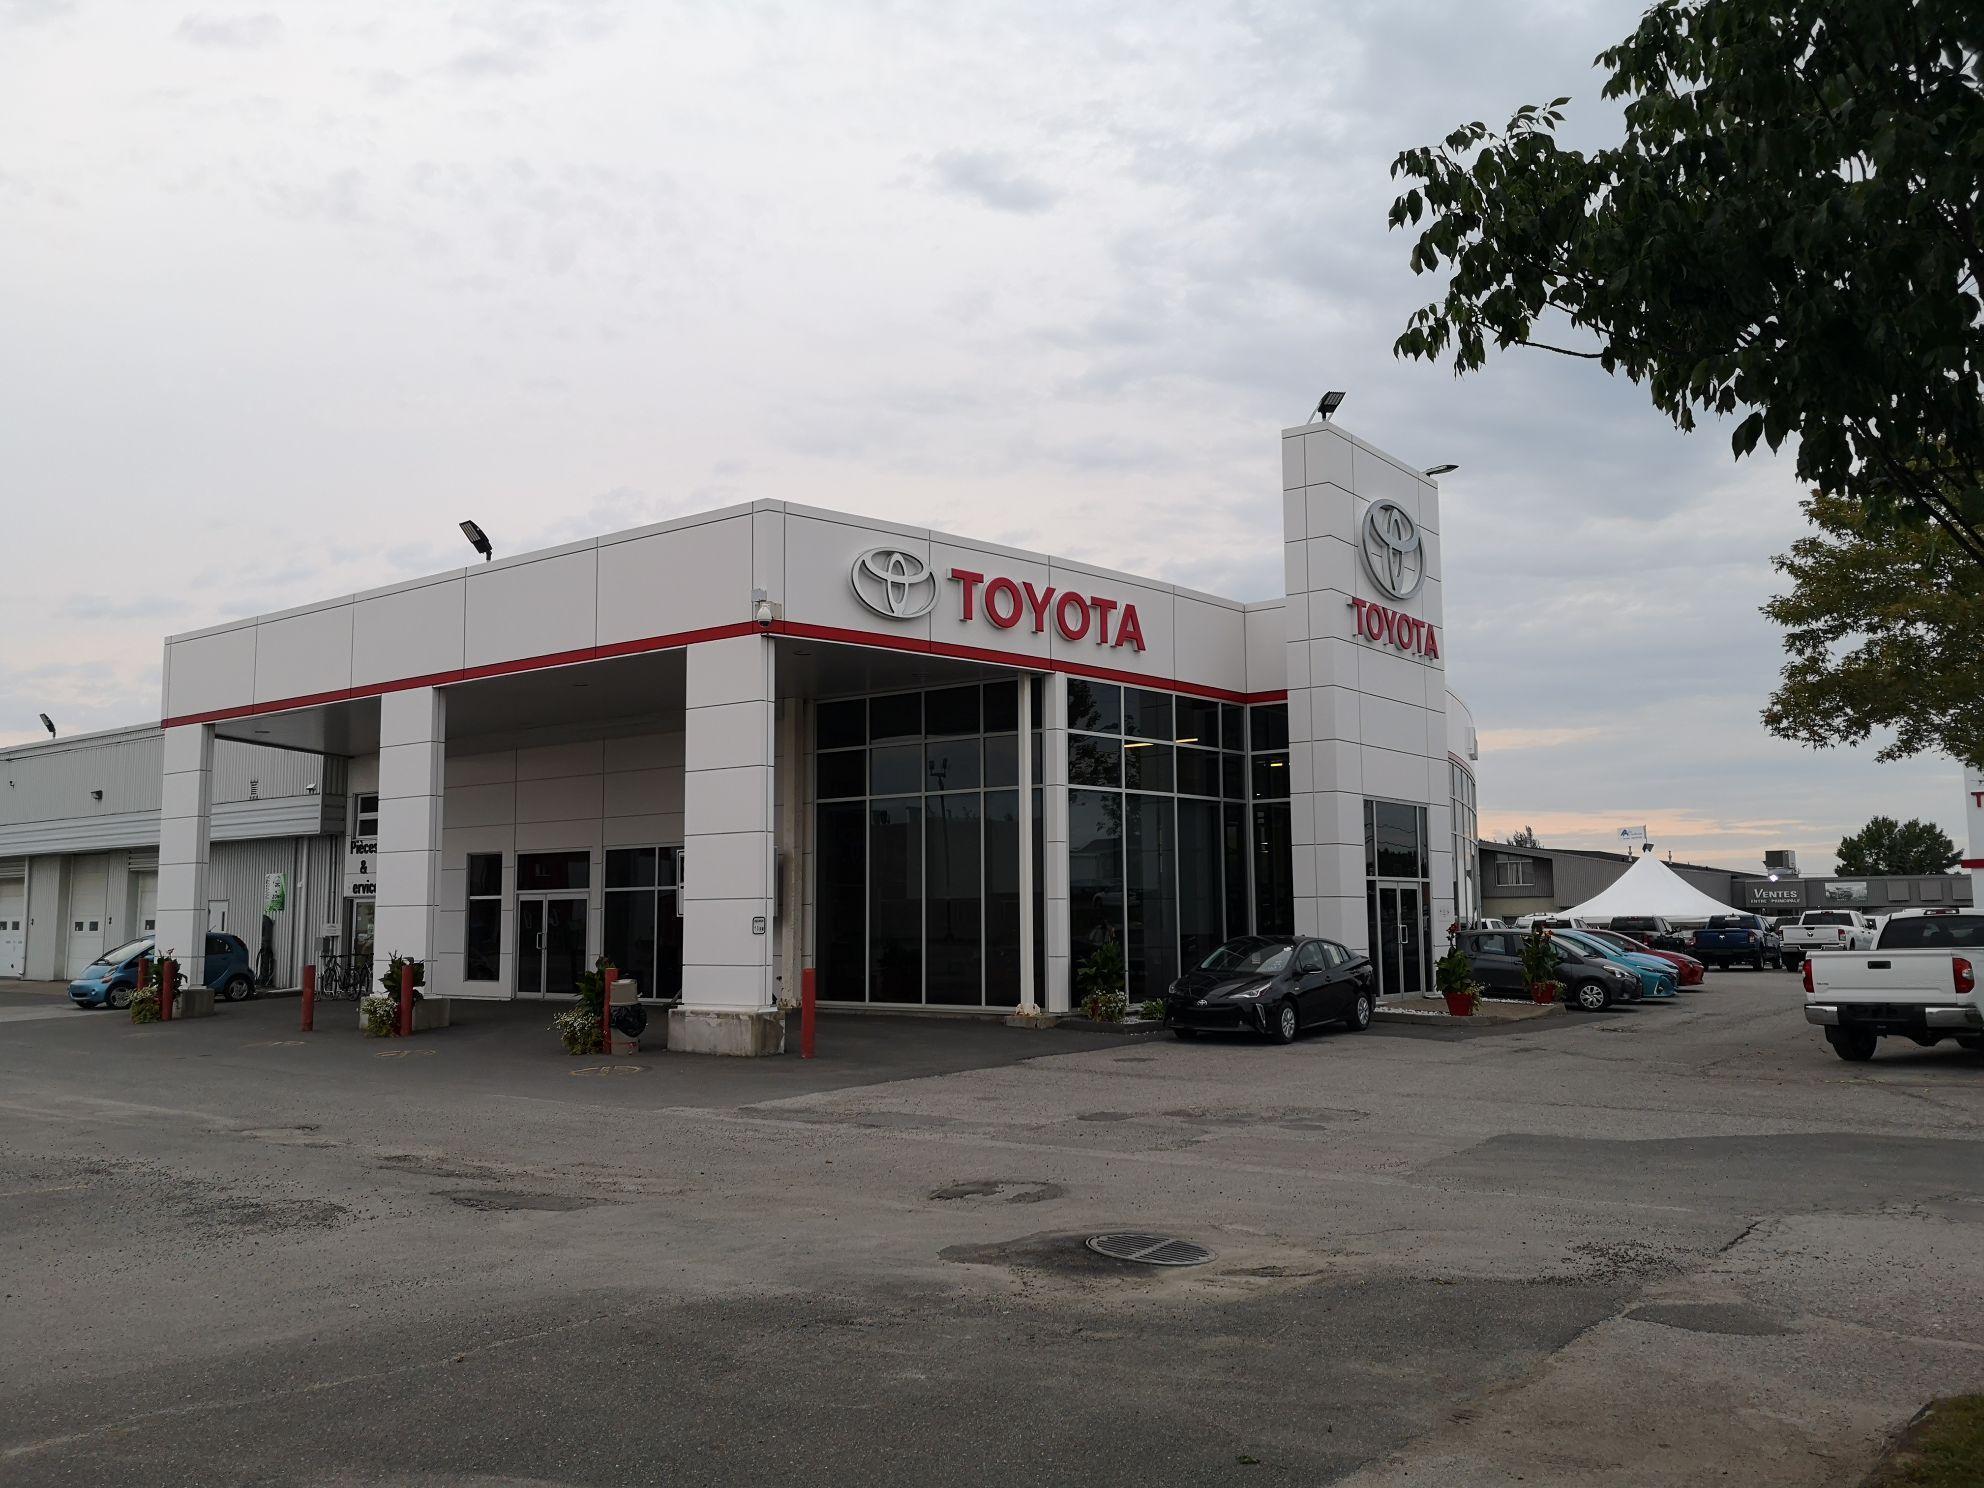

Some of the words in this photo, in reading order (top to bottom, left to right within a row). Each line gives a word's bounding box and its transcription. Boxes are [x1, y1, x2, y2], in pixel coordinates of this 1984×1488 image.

[947, 567, 1146, 652] TOYOTA
[1347, 596, 1440, 660] TOYOTA
[360, 860, 368, 874] &
[1754, 888, 1797, 898] VENTES
